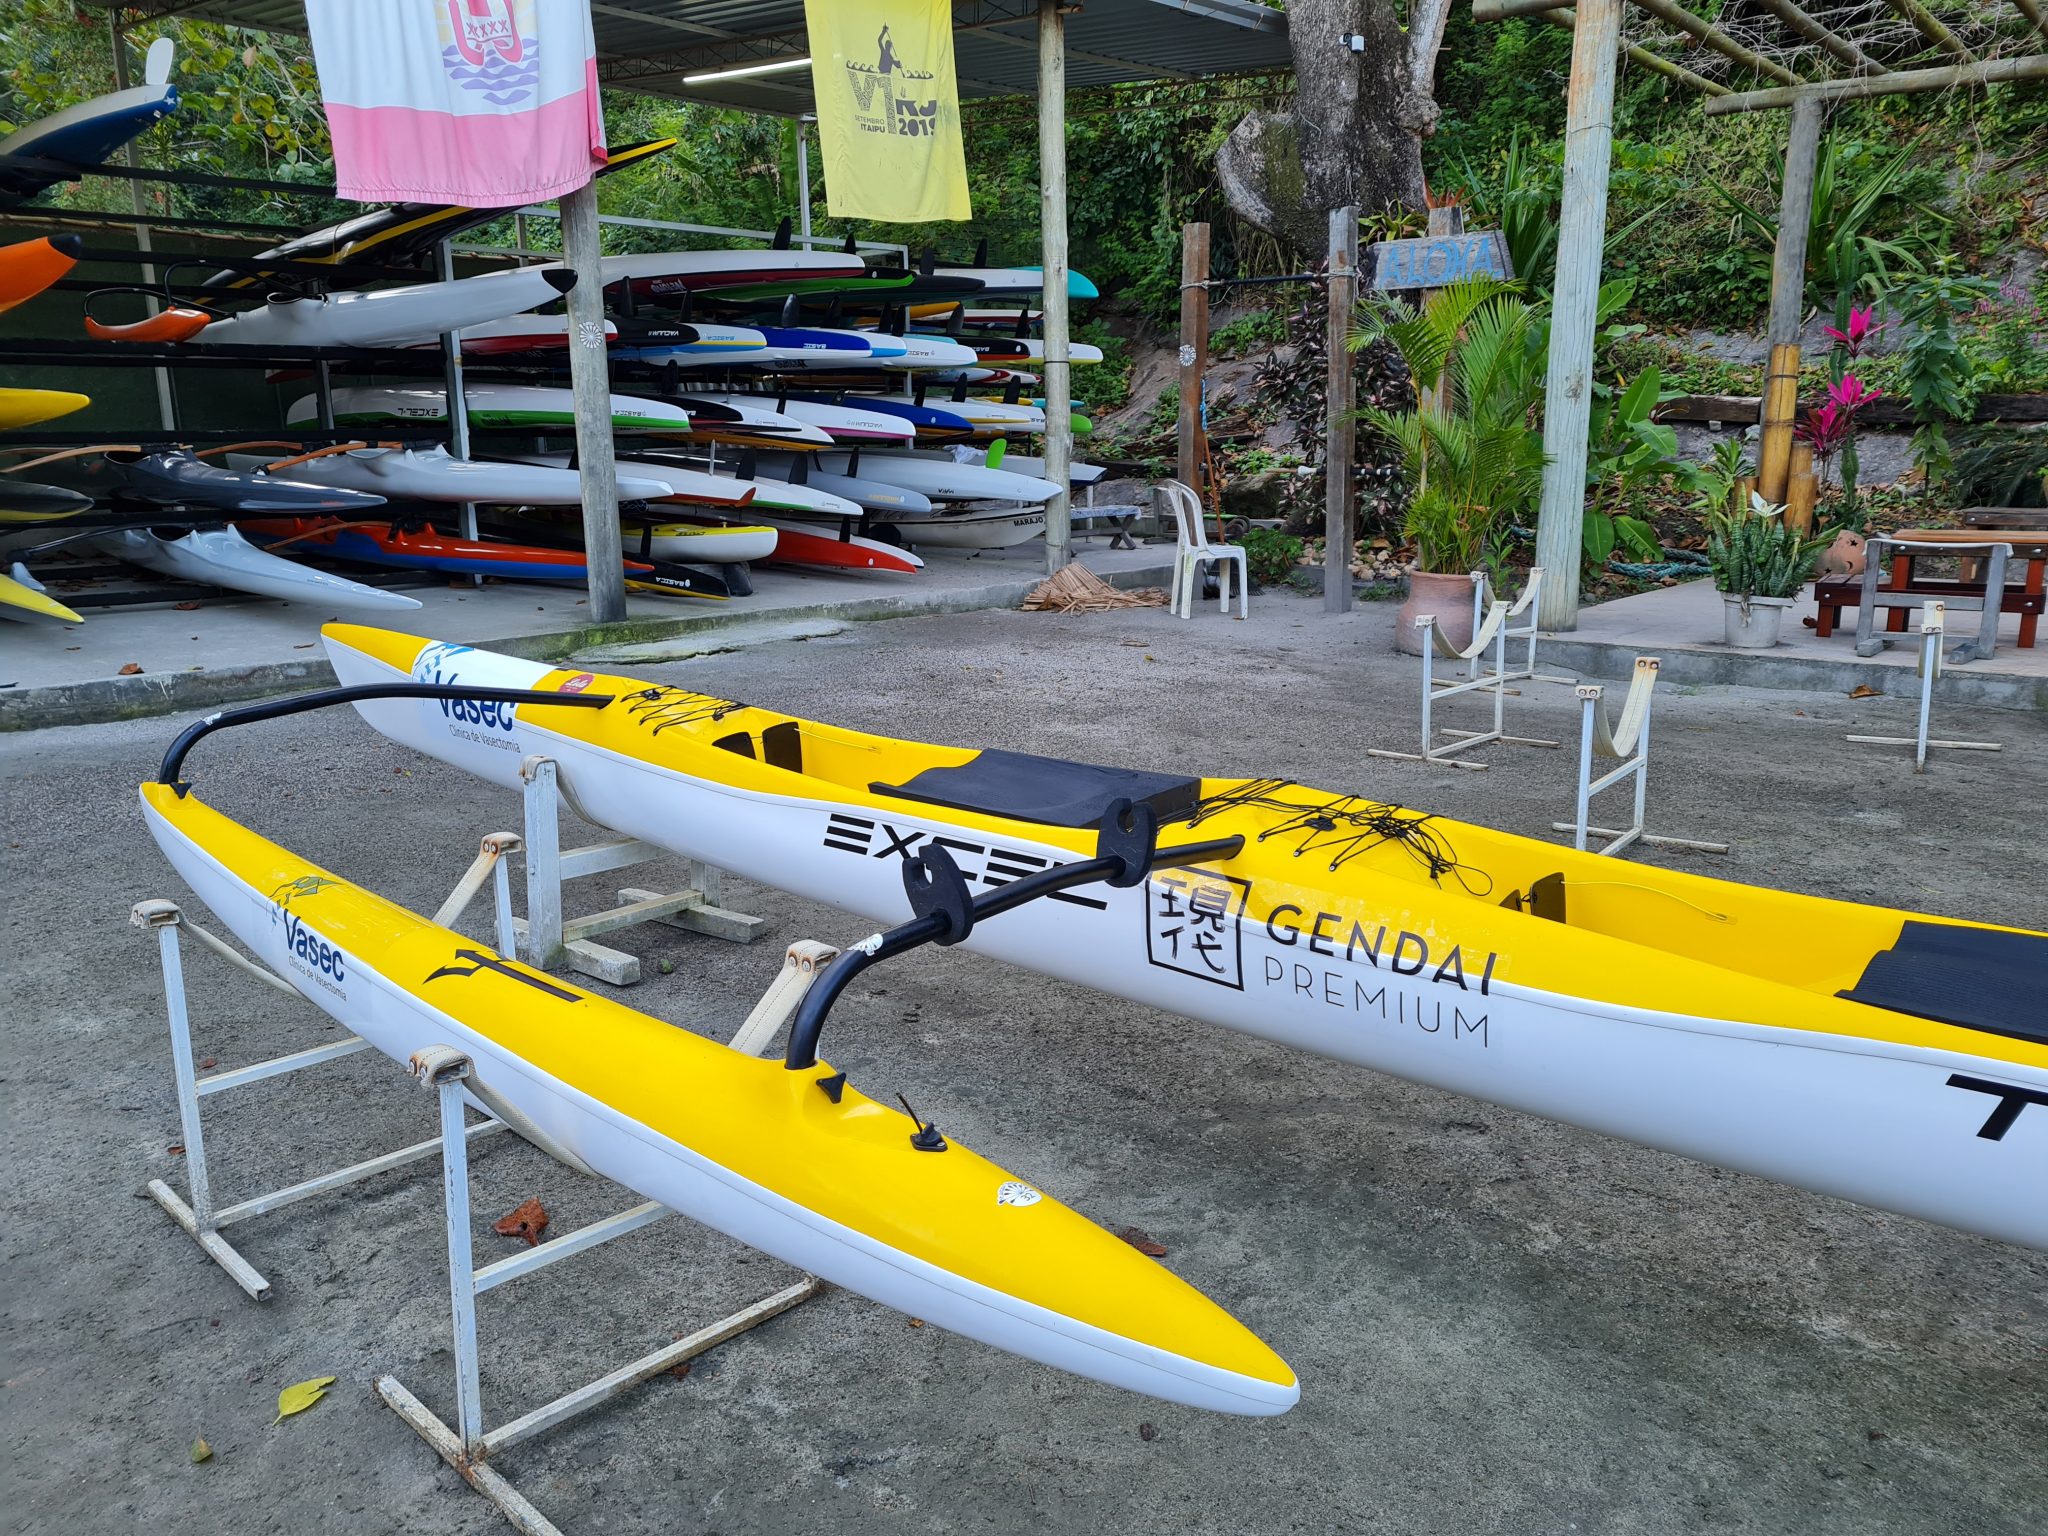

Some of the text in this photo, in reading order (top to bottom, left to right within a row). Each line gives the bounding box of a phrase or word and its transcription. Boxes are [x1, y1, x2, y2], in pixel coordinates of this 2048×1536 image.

[854, 114, 885, 125] SETEMBRO
[860, 123, 886, 134] ITAIPU
[1377, 236, 1504, 290] ALOHA
[655, 576, 685, 587] BASICA
[435, 669, 515, 731] Vasec
[470, 729, 481, 743] de
[479, 730, 521, 754] Vasectomia
[283, 908, 345, 982] Vasec
[1266, 903, 1497, 996] GENDAI
[306, 966, 314, 980] de
[314, 971, 347, 1001] Vasectomia
[1265, 956, 1488, 1049] PREMIUM
